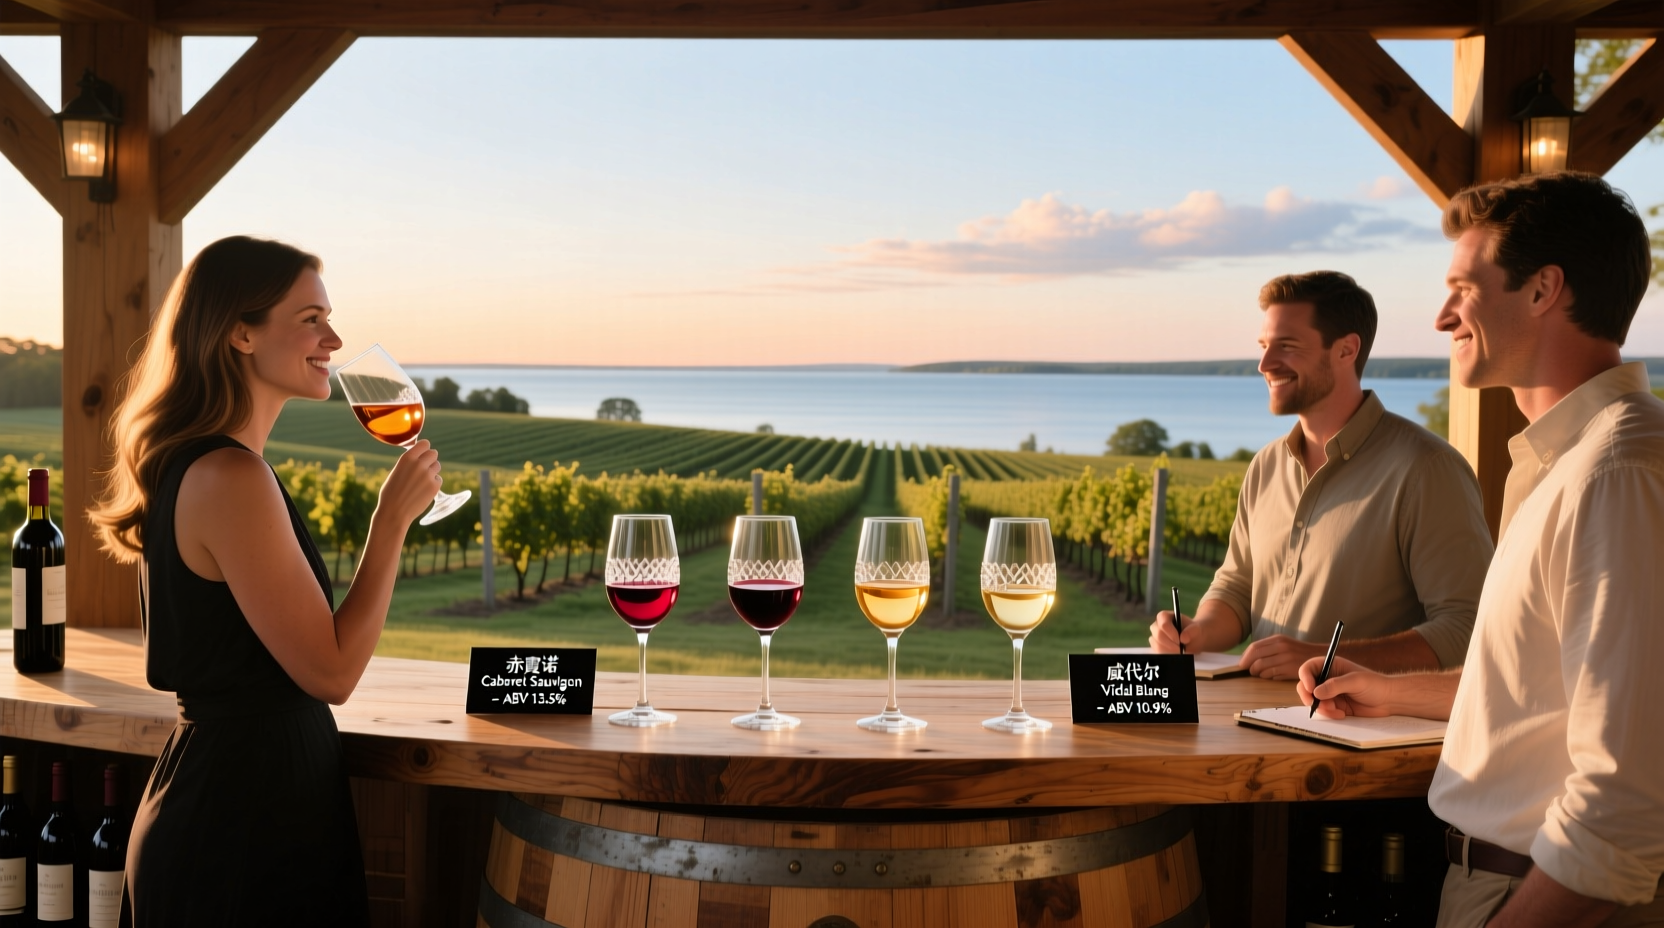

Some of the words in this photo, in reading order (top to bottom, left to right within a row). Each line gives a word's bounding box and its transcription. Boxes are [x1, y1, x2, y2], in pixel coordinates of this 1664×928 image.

[1106, 662, 1160, 682] 威代尔
[1100, 683, 1132, 696] Vidal
[502, 692, 529, 705] ABV
[532, 692, 567, 705] 13.5%
[1107, 702, 1133, 714] ABV
[1136, 702, 1172, 714] 10.9%
